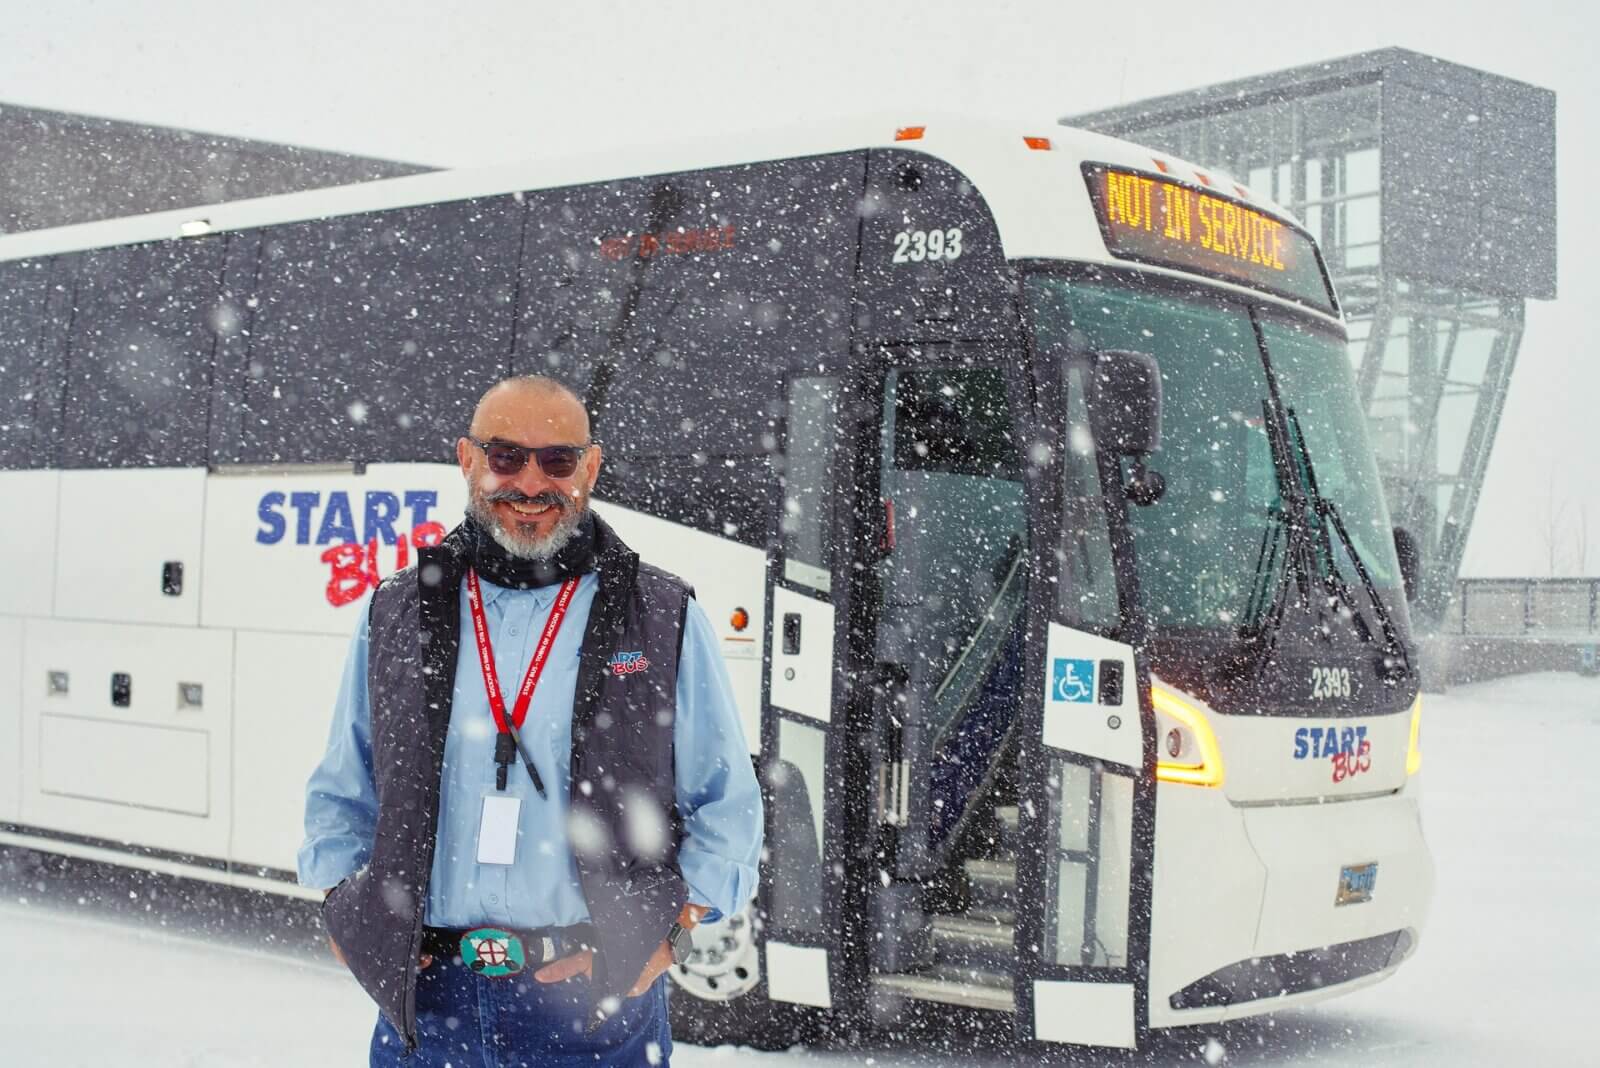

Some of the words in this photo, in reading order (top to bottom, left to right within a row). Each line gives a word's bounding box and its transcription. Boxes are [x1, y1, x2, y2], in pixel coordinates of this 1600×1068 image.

[1107, 172, 1154, 231] NOT
[1163, 184, 1191, 242] IN
[1199, 195, 1285, 270] SERVICE
[892, 227, 963, 263] 2393
[255, 491, 438, 546] START
[546, 612, 560, 637] JACKSON
[613, 656, 648, 675] BUS
[1312, 667, 1350, 698] 2393
[1294, 726, 1367, 759] START
[1331, 741, 1371, 783] BUS
